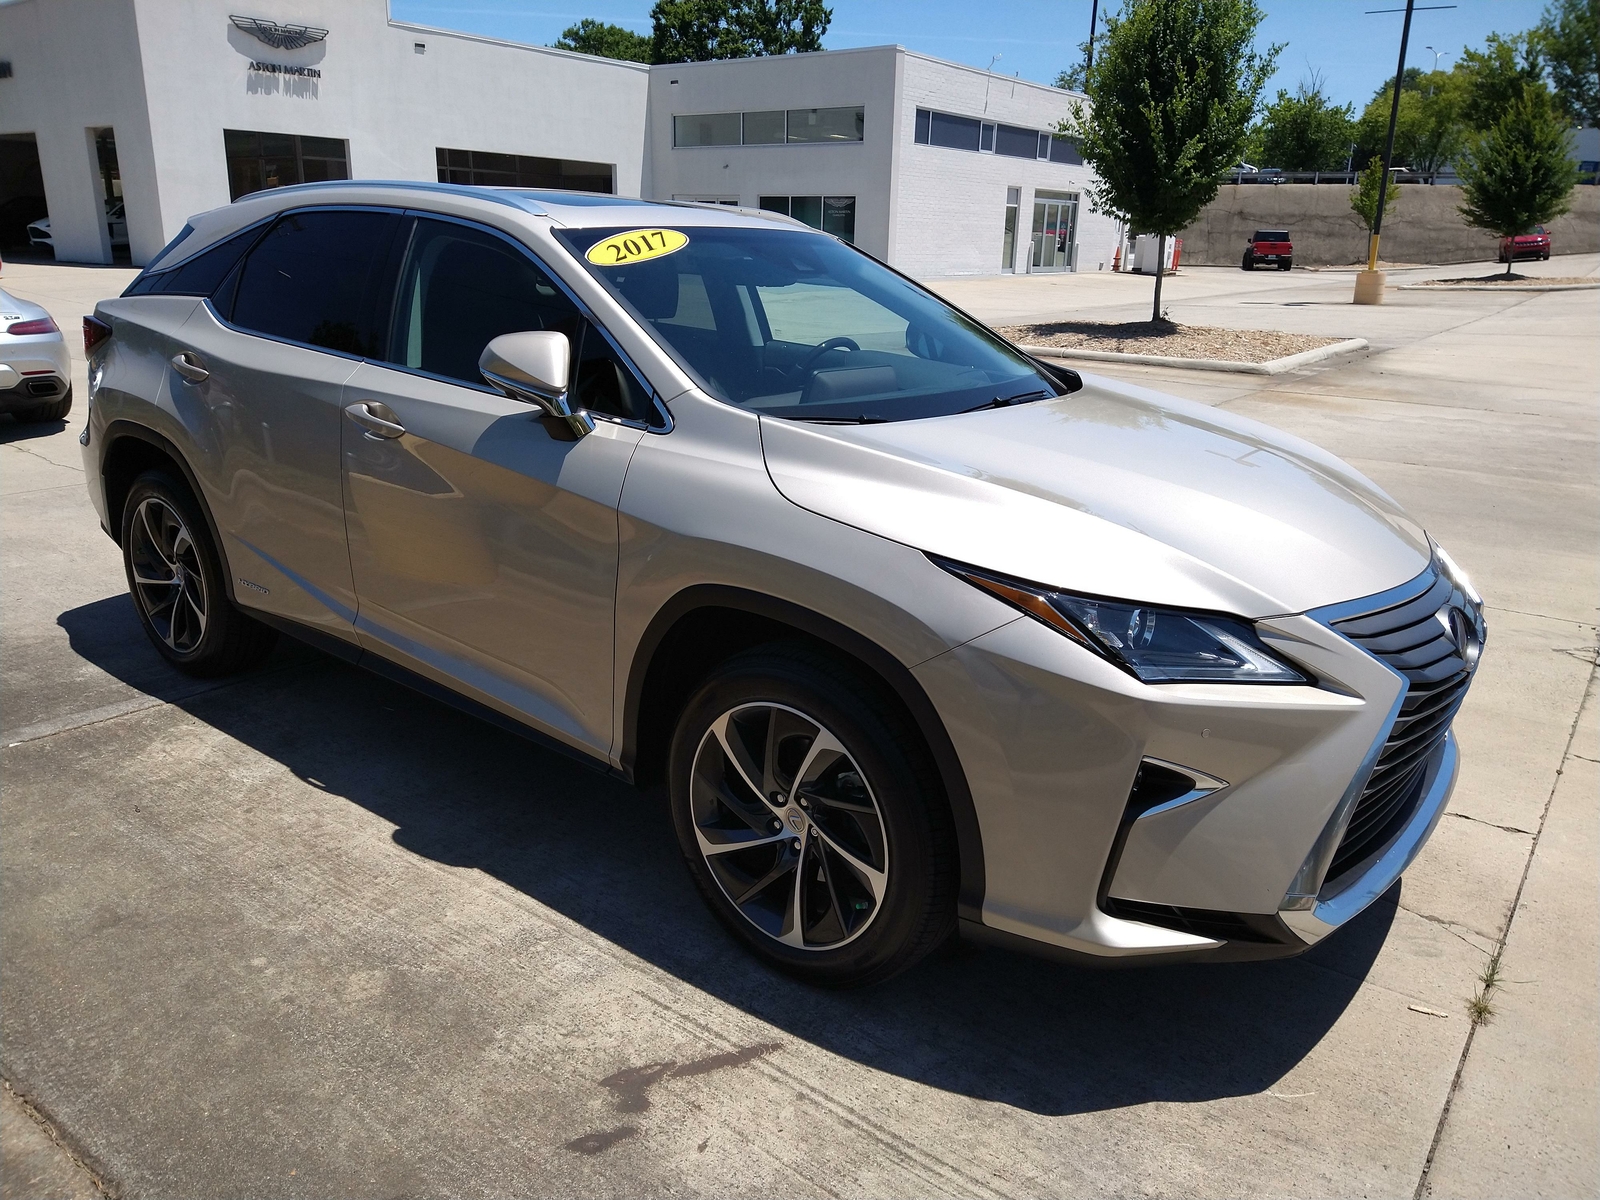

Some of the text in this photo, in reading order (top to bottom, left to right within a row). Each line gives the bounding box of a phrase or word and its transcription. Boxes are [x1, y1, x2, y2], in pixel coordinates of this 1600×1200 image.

[248, 61, 321, 78] ASTON MARTIN
[606, 231, 666, 262] 2017
